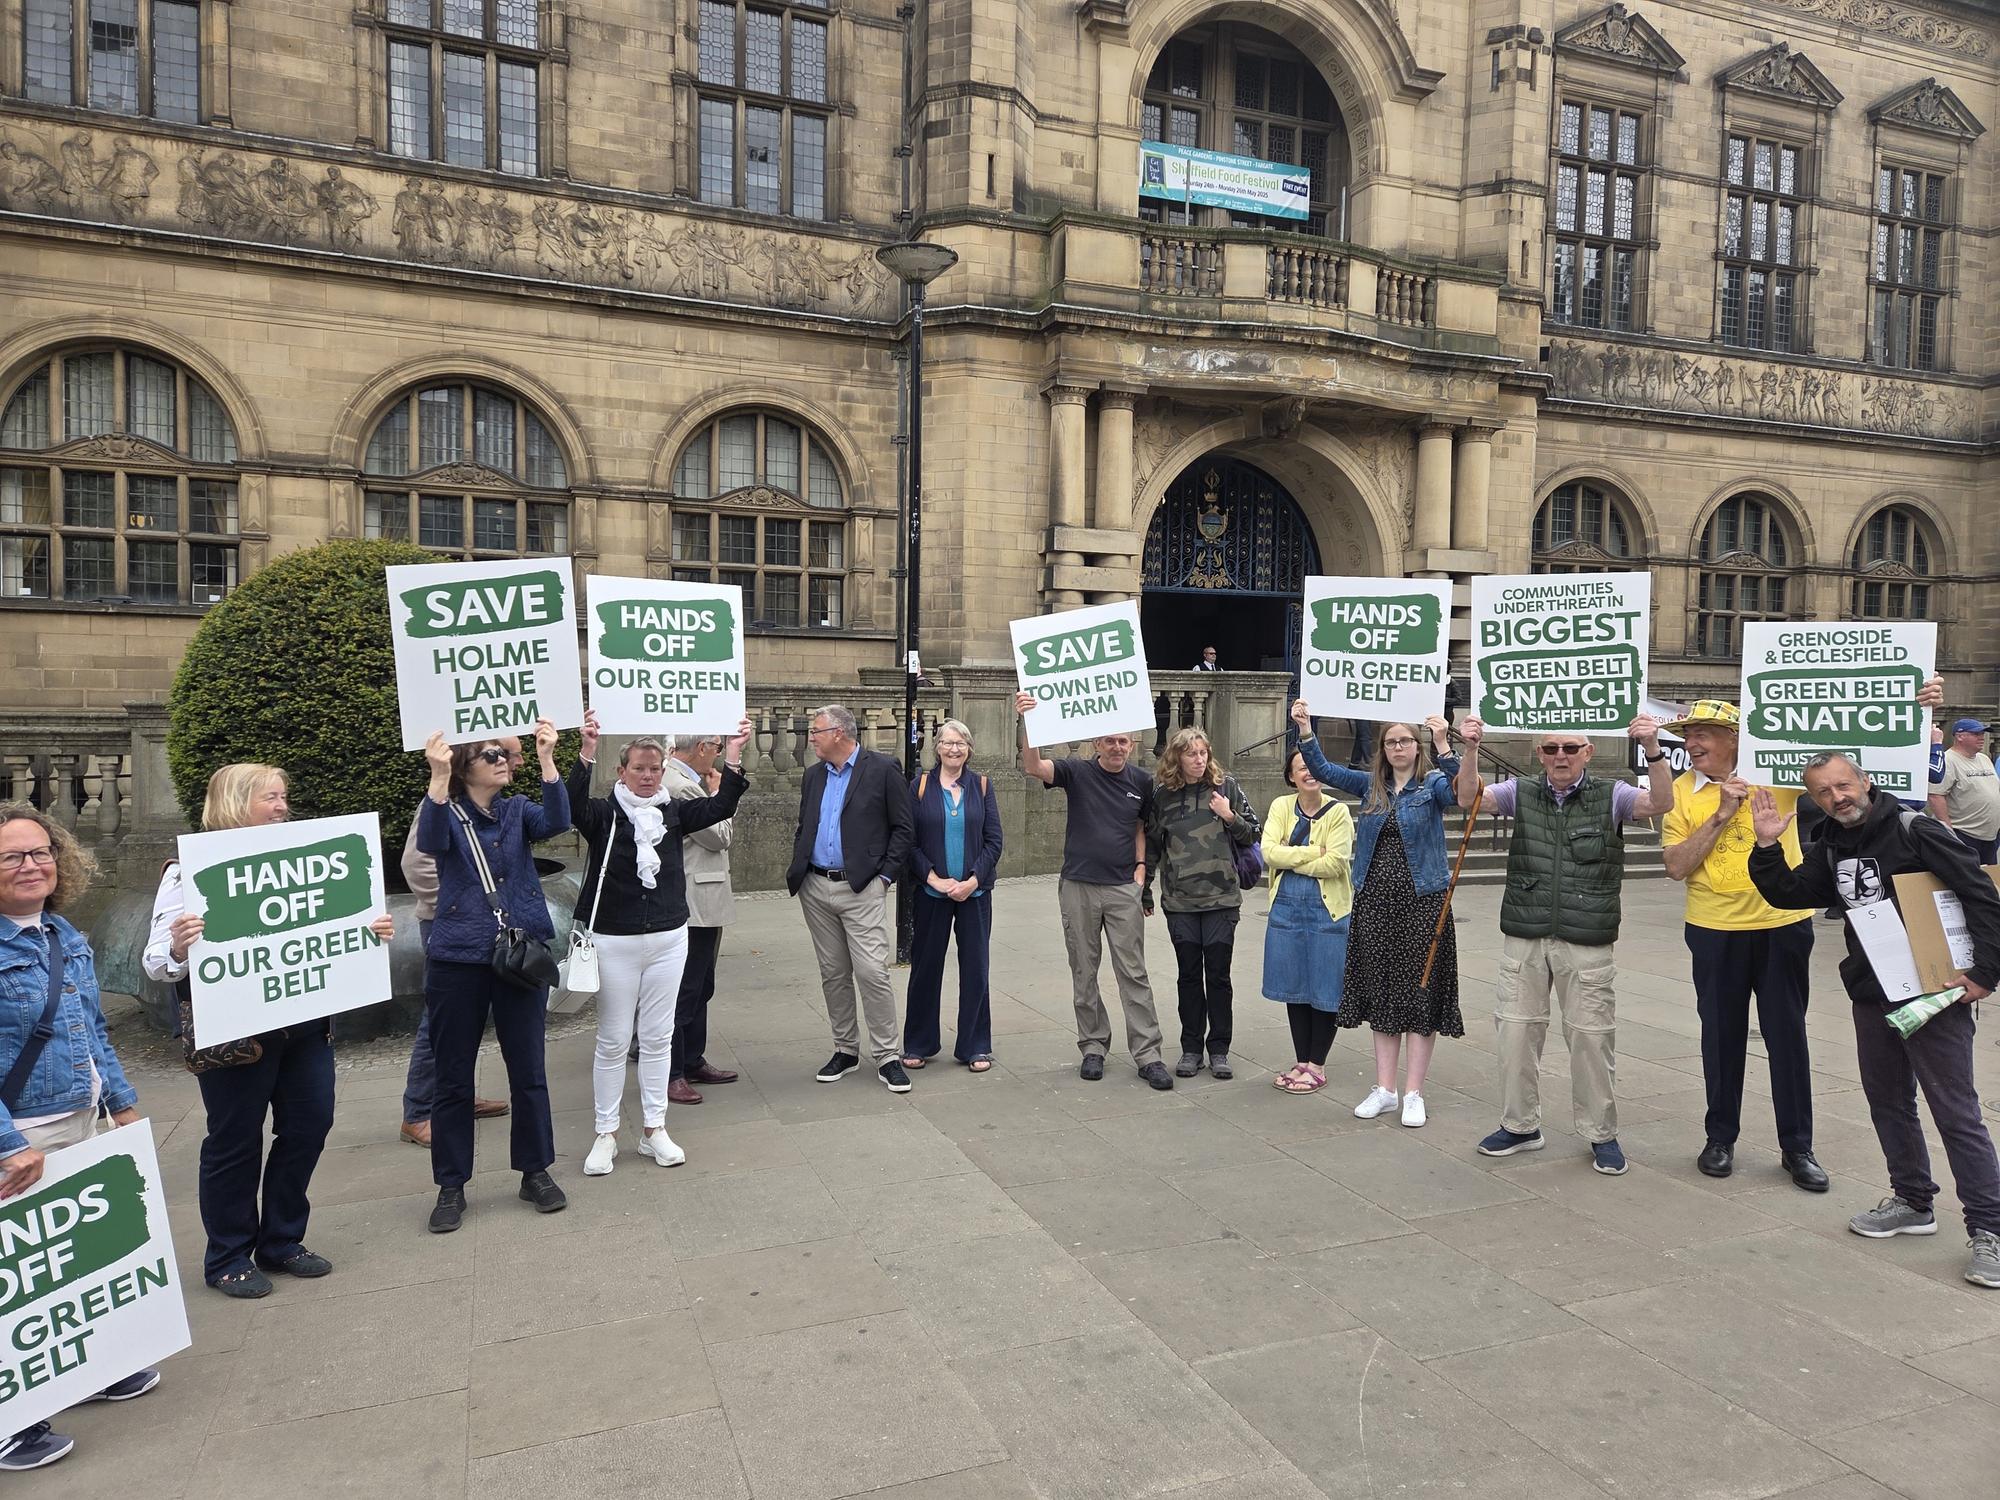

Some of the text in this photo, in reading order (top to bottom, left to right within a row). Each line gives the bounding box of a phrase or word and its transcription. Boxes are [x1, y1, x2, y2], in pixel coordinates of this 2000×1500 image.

[1237, 158, 1252, 167] STREET
[1218, 170, 1241, 184] Food
[1243, 173, 1279, 190] Festival
[1219, 184, 1234, 194] Monday
[1248, 188, 1256, 198] May
[1502, 582, 1614, 601] COMMUNITIES
[426, 584, 548, 629] SAVE
[1330, 602, 1422, 627] HANDS
[1494, 595, 1624, 615] UNDER THREAT IN
[620, 605, 716, 633] HANDS
[1480, 611, 1641, 648] BIGGEST
[642, 634, 696, 658] OFF
[1037, 630, 1124, 669] SAVE
[1348, 627, 1400, 651] OFF
[1778, 629, 1892, 647] GRENOSIDE
[432, 638, 550, 674] HOLME
[1765, 646, 1908, 664] & ECCLESFIELD
[594, 668, 740, 691] OUR GREEN
[1305, 658, 1442, 683] OUR GREEN
[1495, 657, 1628, 680] GREEN BELT
[454, 670, 536, 702] LANE
[1024, 669, 1138, 703] TOWN END
[1345, 681, 1398, 703] BELT
[1493, 681, 1632, 710] SNATCH
[1765, 680, 1911, 700] GREEN BELT
[643, 693, 699, 714] BELT
[1059, 695, 1118, 720] FARM
[454, 700, 539, 734] FARM
[1506, 708, 1620, 725] IN SHEFFIELD
[1762, 705, 1914, 732] SNATCH
[227, 850, 350, 899] HANDS
[259, 888, 325, 926] OFF
[1868, 910, 1876, 920] S
[198, 925, 381, 984] OUR GREEN
[263, 964, 331, 1003] BELT
[1902, 982, 1911, 992] S
[0, 1184, 109, 1259] NDS
[11, 1257, 168, 1352] GREEN
[0, 1328, 93, 1404] BELT
